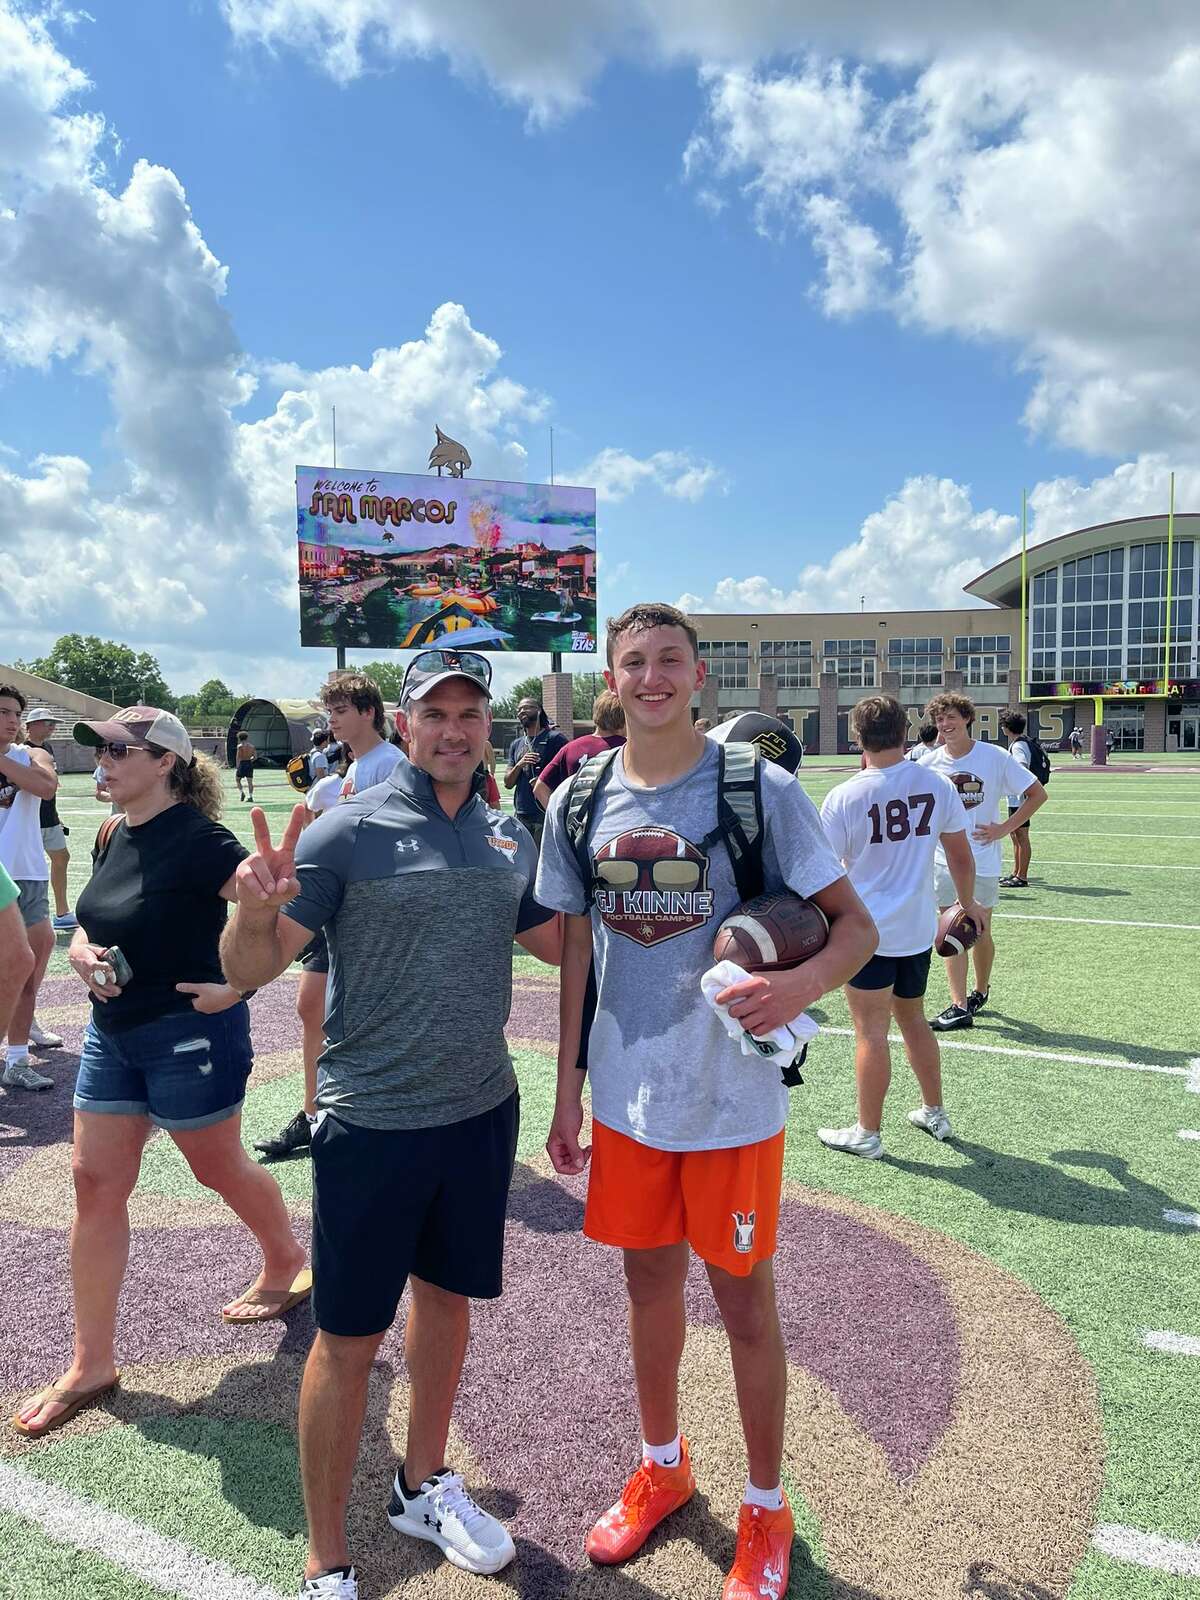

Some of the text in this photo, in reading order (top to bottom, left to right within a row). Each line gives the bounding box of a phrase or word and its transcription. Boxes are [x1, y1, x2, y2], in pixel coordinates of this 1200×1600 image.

[314, 480, 361, 492] WELCOME
[309, 491, 457, 527] SAN MARCOS
[867, 792, 935, 844] 187
[623, 890, 712, 915] KINNE
